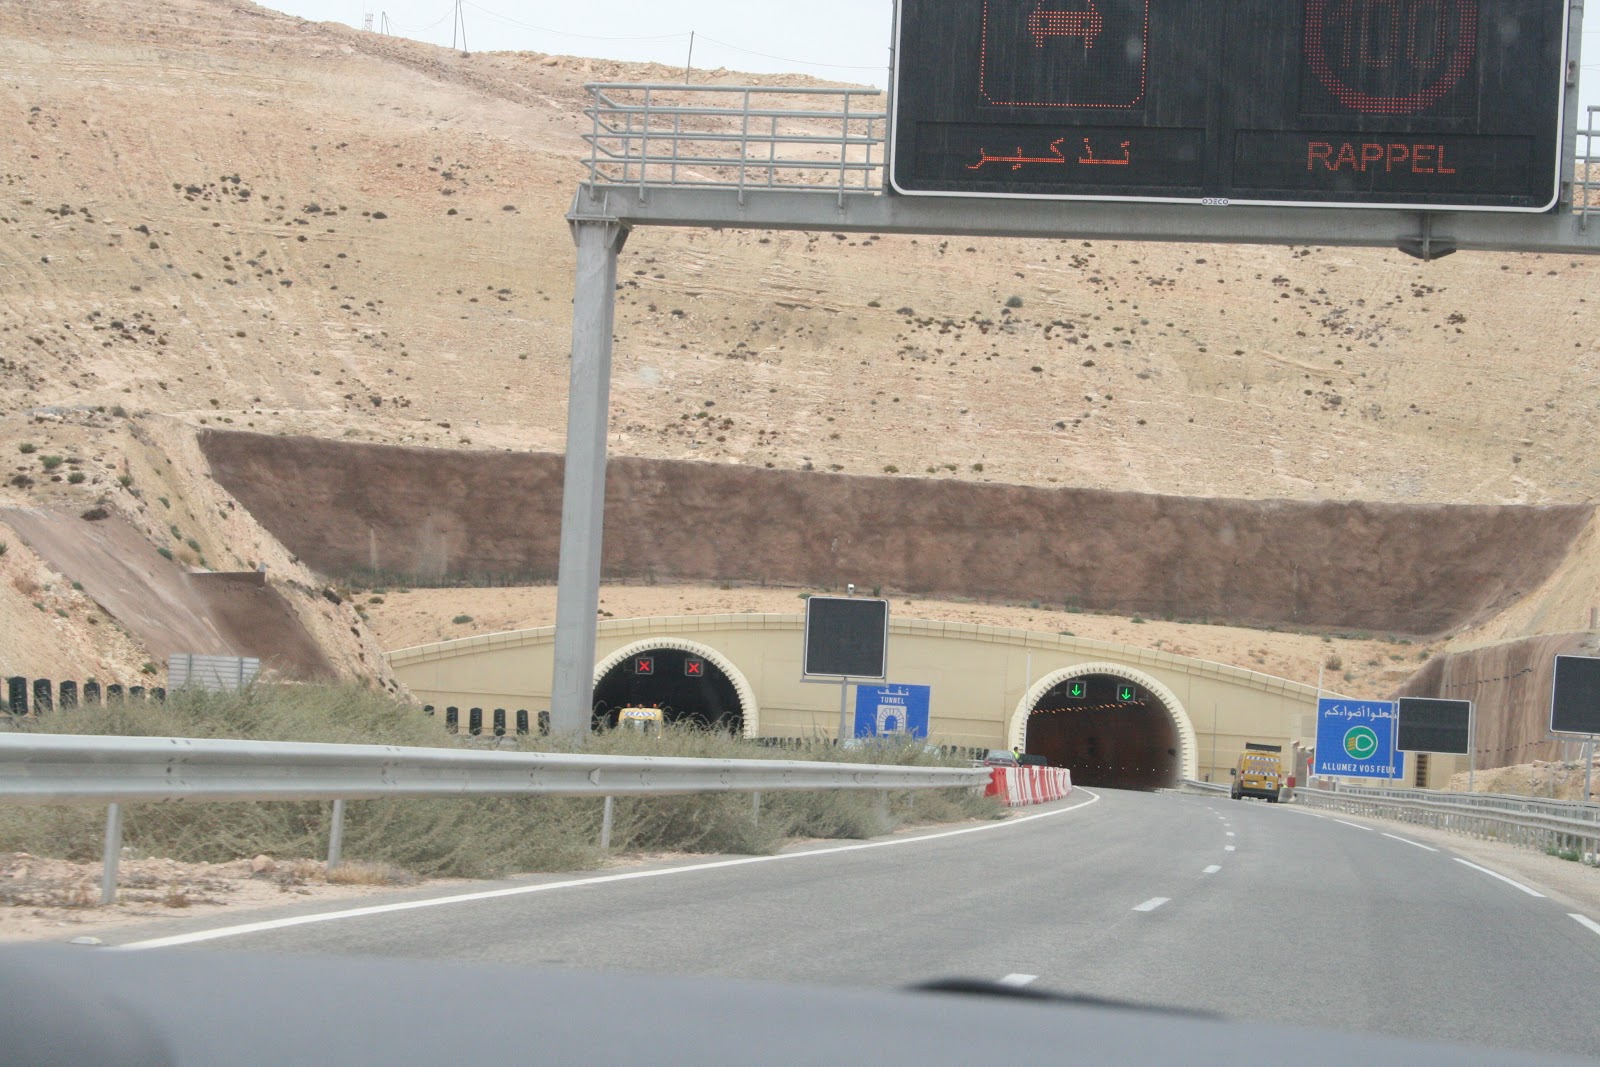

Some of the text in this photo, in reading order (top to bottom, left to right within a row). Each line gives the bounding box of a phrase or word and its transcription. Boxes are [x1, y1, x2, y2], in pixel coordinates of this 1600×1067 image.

[965, 137, 1130, 170] تذكير
[1307, 141, 1456, 174] RAPPEL
[880, 696, 905, 705] TUNNEL
[1321, 762, 1396, 774] ALLUMEZ VOS FEUX
